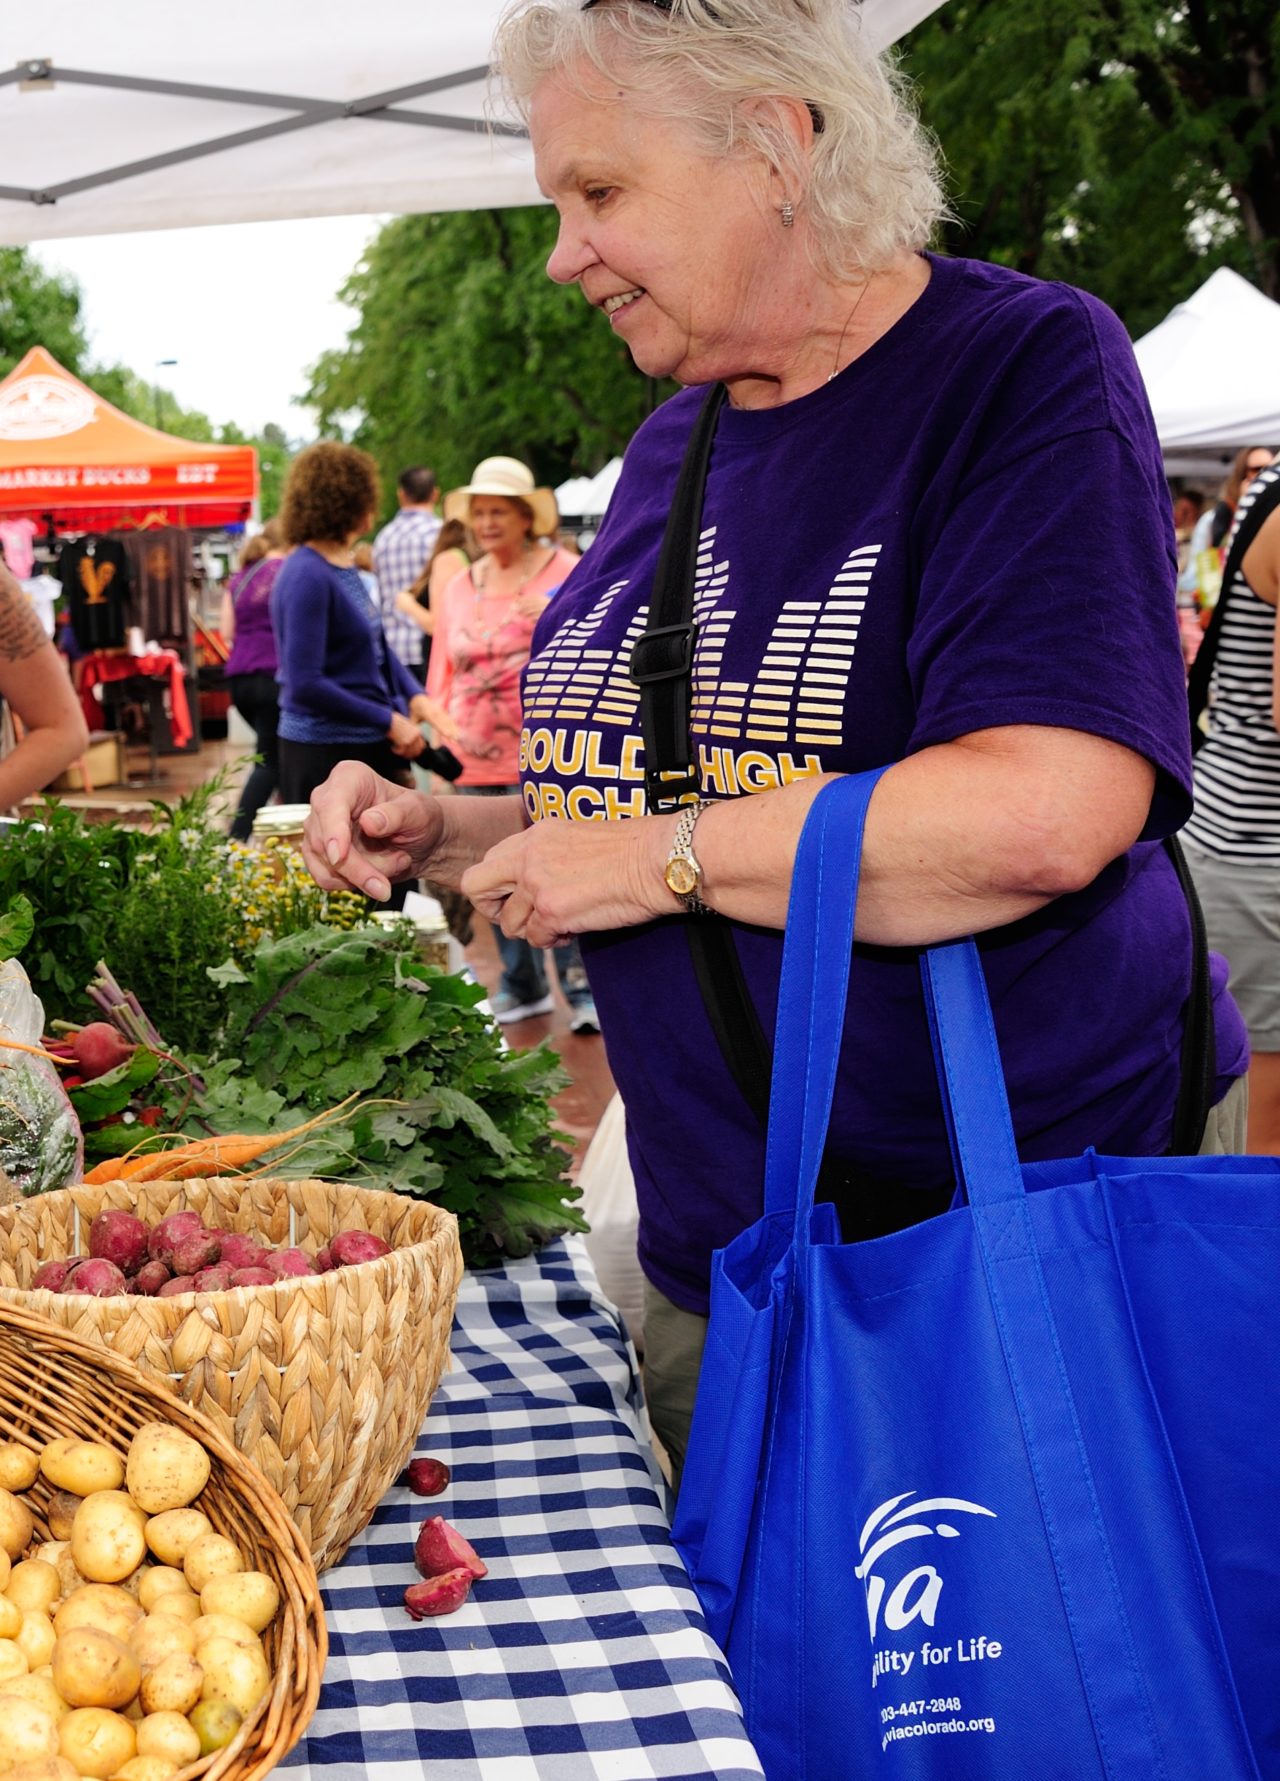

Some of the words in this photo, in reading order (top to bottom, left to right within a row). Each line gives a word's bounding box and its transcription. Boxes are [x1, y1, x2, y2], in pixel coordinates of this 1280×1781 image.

[520, 727, 694, 782] BOULD
[696, 743, 823, 796] HIGH
[522, 780, 700, 822] ORCH
[872, 1650, 915, 1688] ility
[921, 1642, 953, 1665] for
[957, 1636, 1003, 1662] Life
[882, 1717, 996, 1752] viacolorado.org
